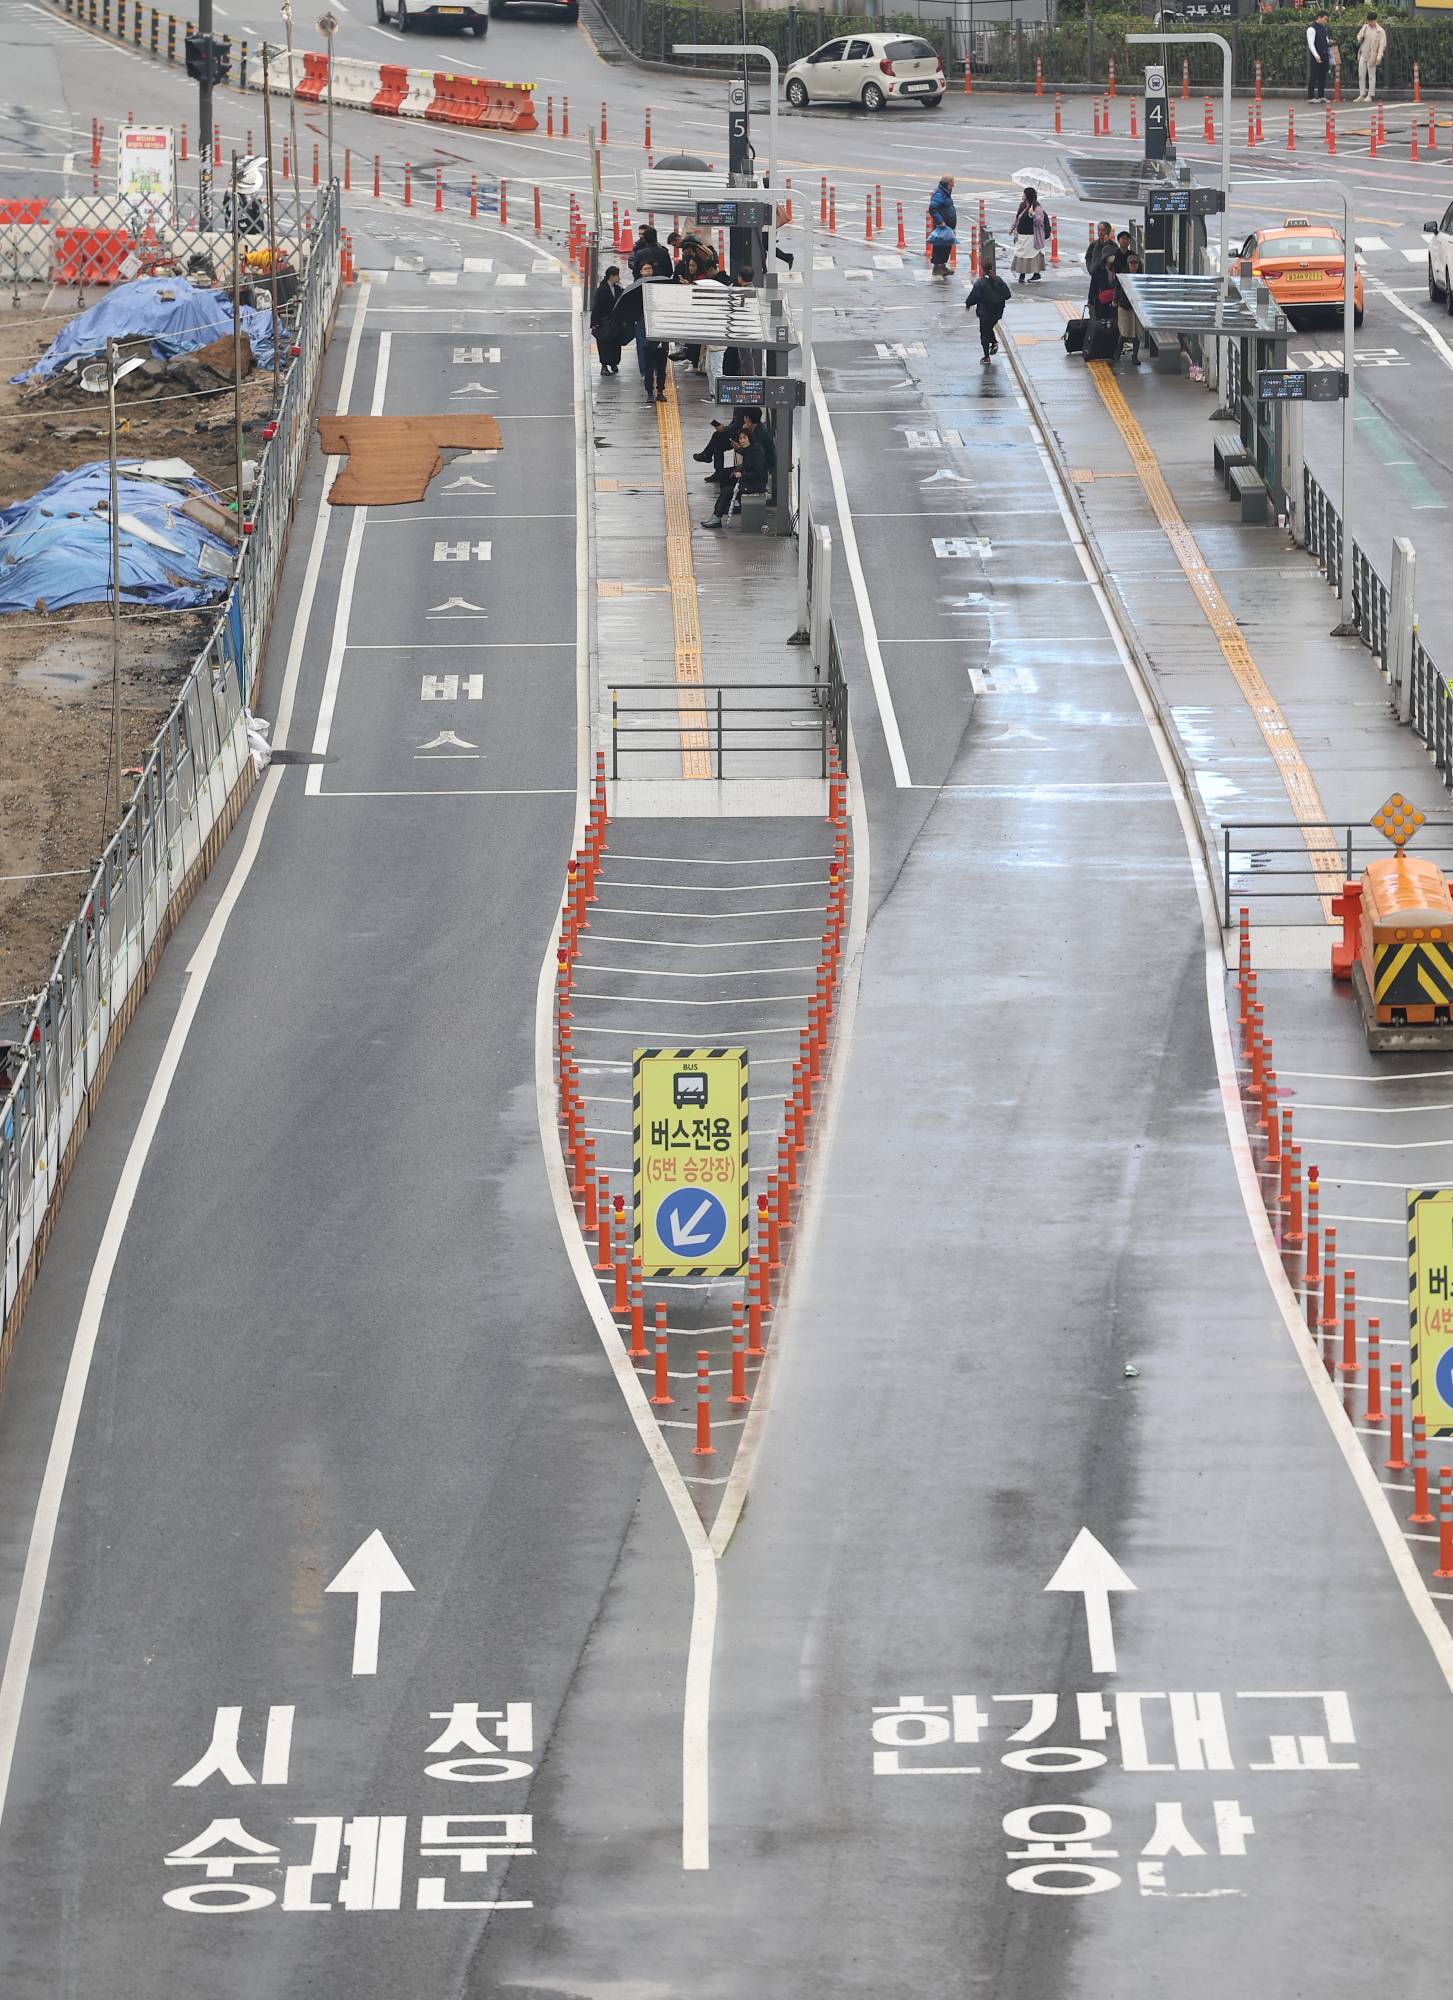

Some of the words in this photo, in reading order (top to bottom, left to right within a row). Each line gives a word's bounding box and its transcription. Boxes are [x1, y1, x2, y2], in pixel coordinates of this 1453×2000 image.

[1186, 5, 1208, 16] 구두
[733, 118, 745, 137] 5
[1150, 104, 1162, 123] 4
[651, 1117, 731, 1152] 버스전용
[646, 1155, 677, 1184] (5번
[683, 1155, 735, 1184] 승강장)
[1429, 1264, 1453, 1301] 버
[871, 1690, 1361, 1775] 한강대교
[161, 1813, 537, 1914] 숭례문
[1001, 1799, 1257, 1898] 용산
